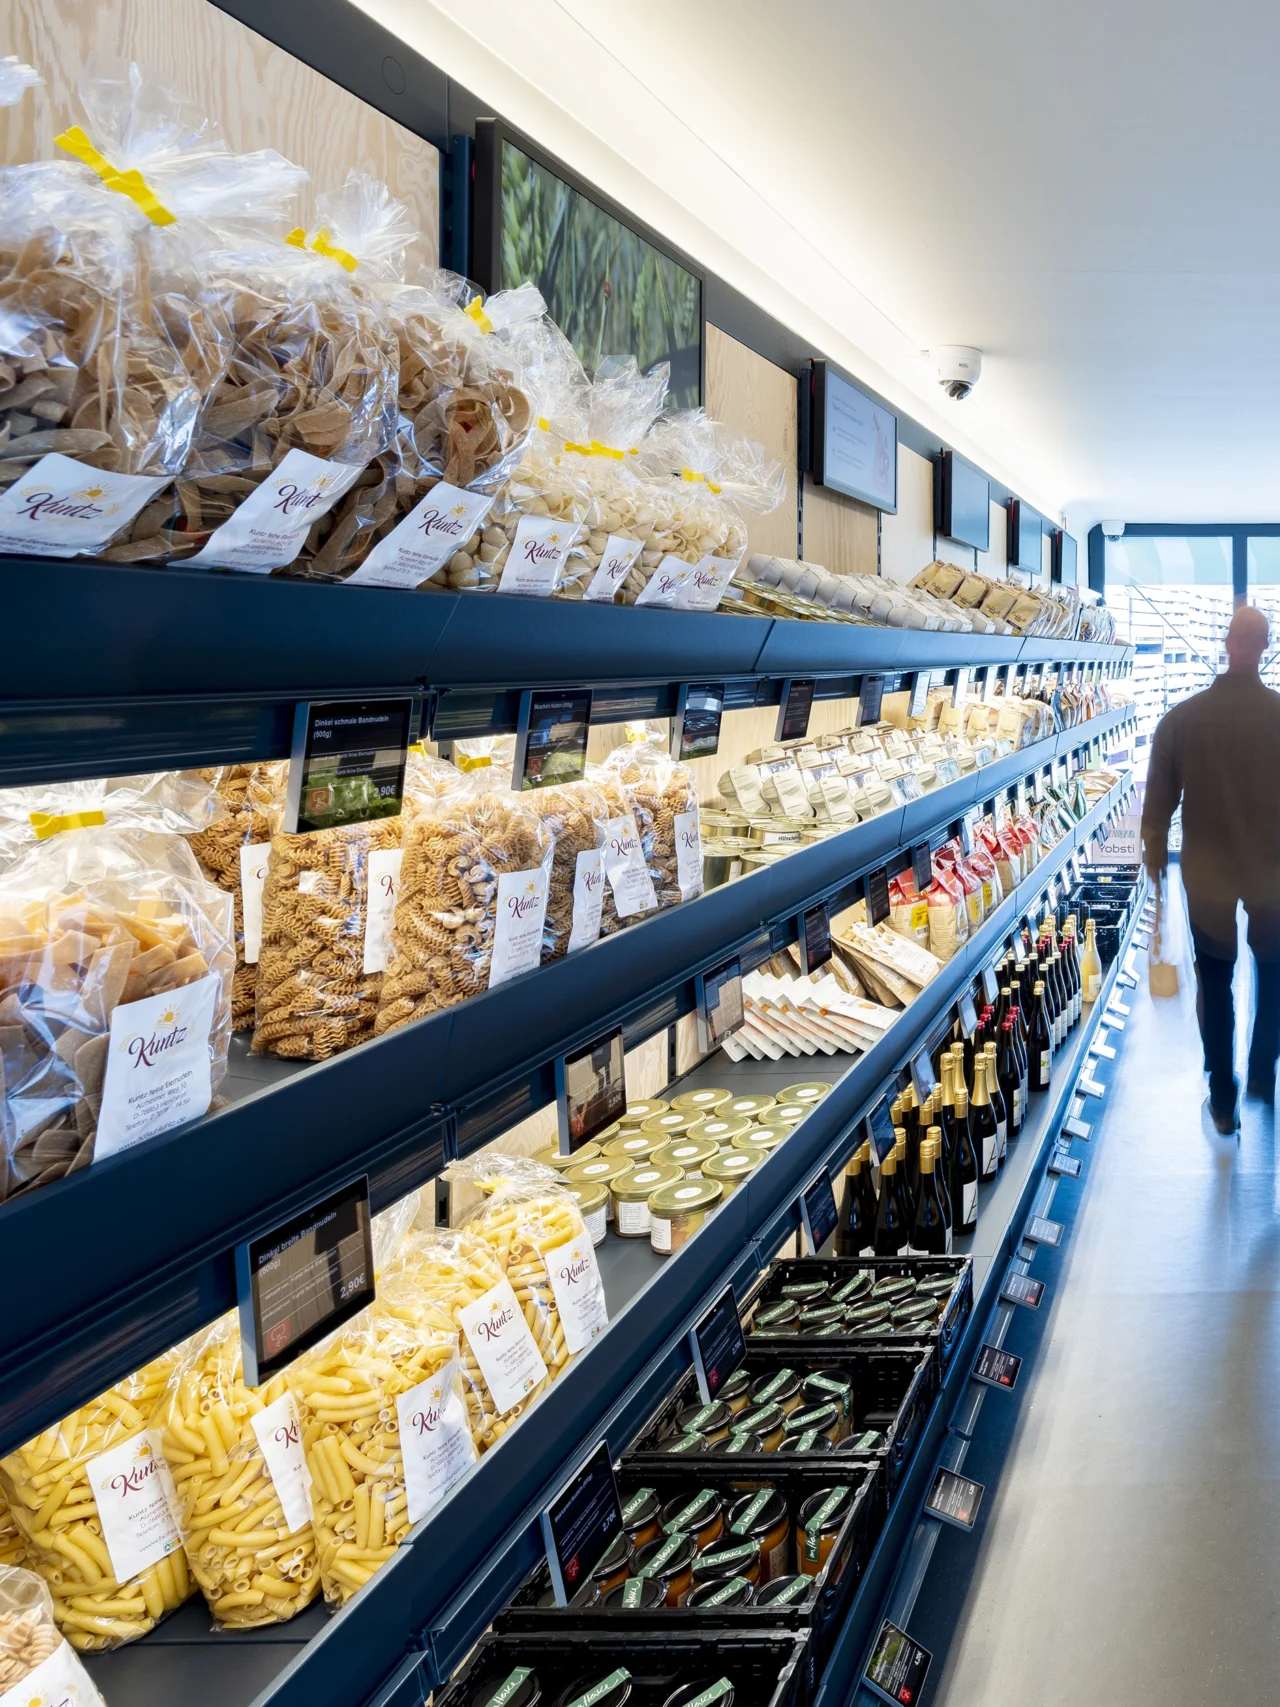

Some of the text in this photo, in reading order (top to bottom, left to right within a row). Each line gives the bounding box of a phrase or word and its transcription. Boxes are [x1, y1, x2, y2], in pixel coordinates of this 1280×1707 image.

[17, 492, 103, 520] Kuntz
[274, 484, 323, 515] Kunt
[418, 509, 463, 536] Kuntz
[525, 540, 561, 564] Kuntz
[694, 571, 719, 589] Kuntz
[315, 716, 389, 727] Dinkel schmale Bandnudeln
[313, 730, 332, 739] (500g)
[374, 785, 395, 797] 2,90€
[610, 838, 639, 856] Kuntz
[508, 896, 540, 918] Kuntz
[128, 1026, 187, 1069] Kuntz
[128, 1091, 147, 1104] Kuntz
[259, 1211, 337, 1264] Dinkel breite Bandnudeln
[259, 1259, 281, 1277] (500g)
[561, 1258, 590, 1285] Kuntz
[340, 1273, 365, 1299] 2,90€
[478, 1309, 513, 1342] Kuntz
[128, 1508, 148, 1521] Kuntz
[602, 1509, 617, 1532] 2,70€
